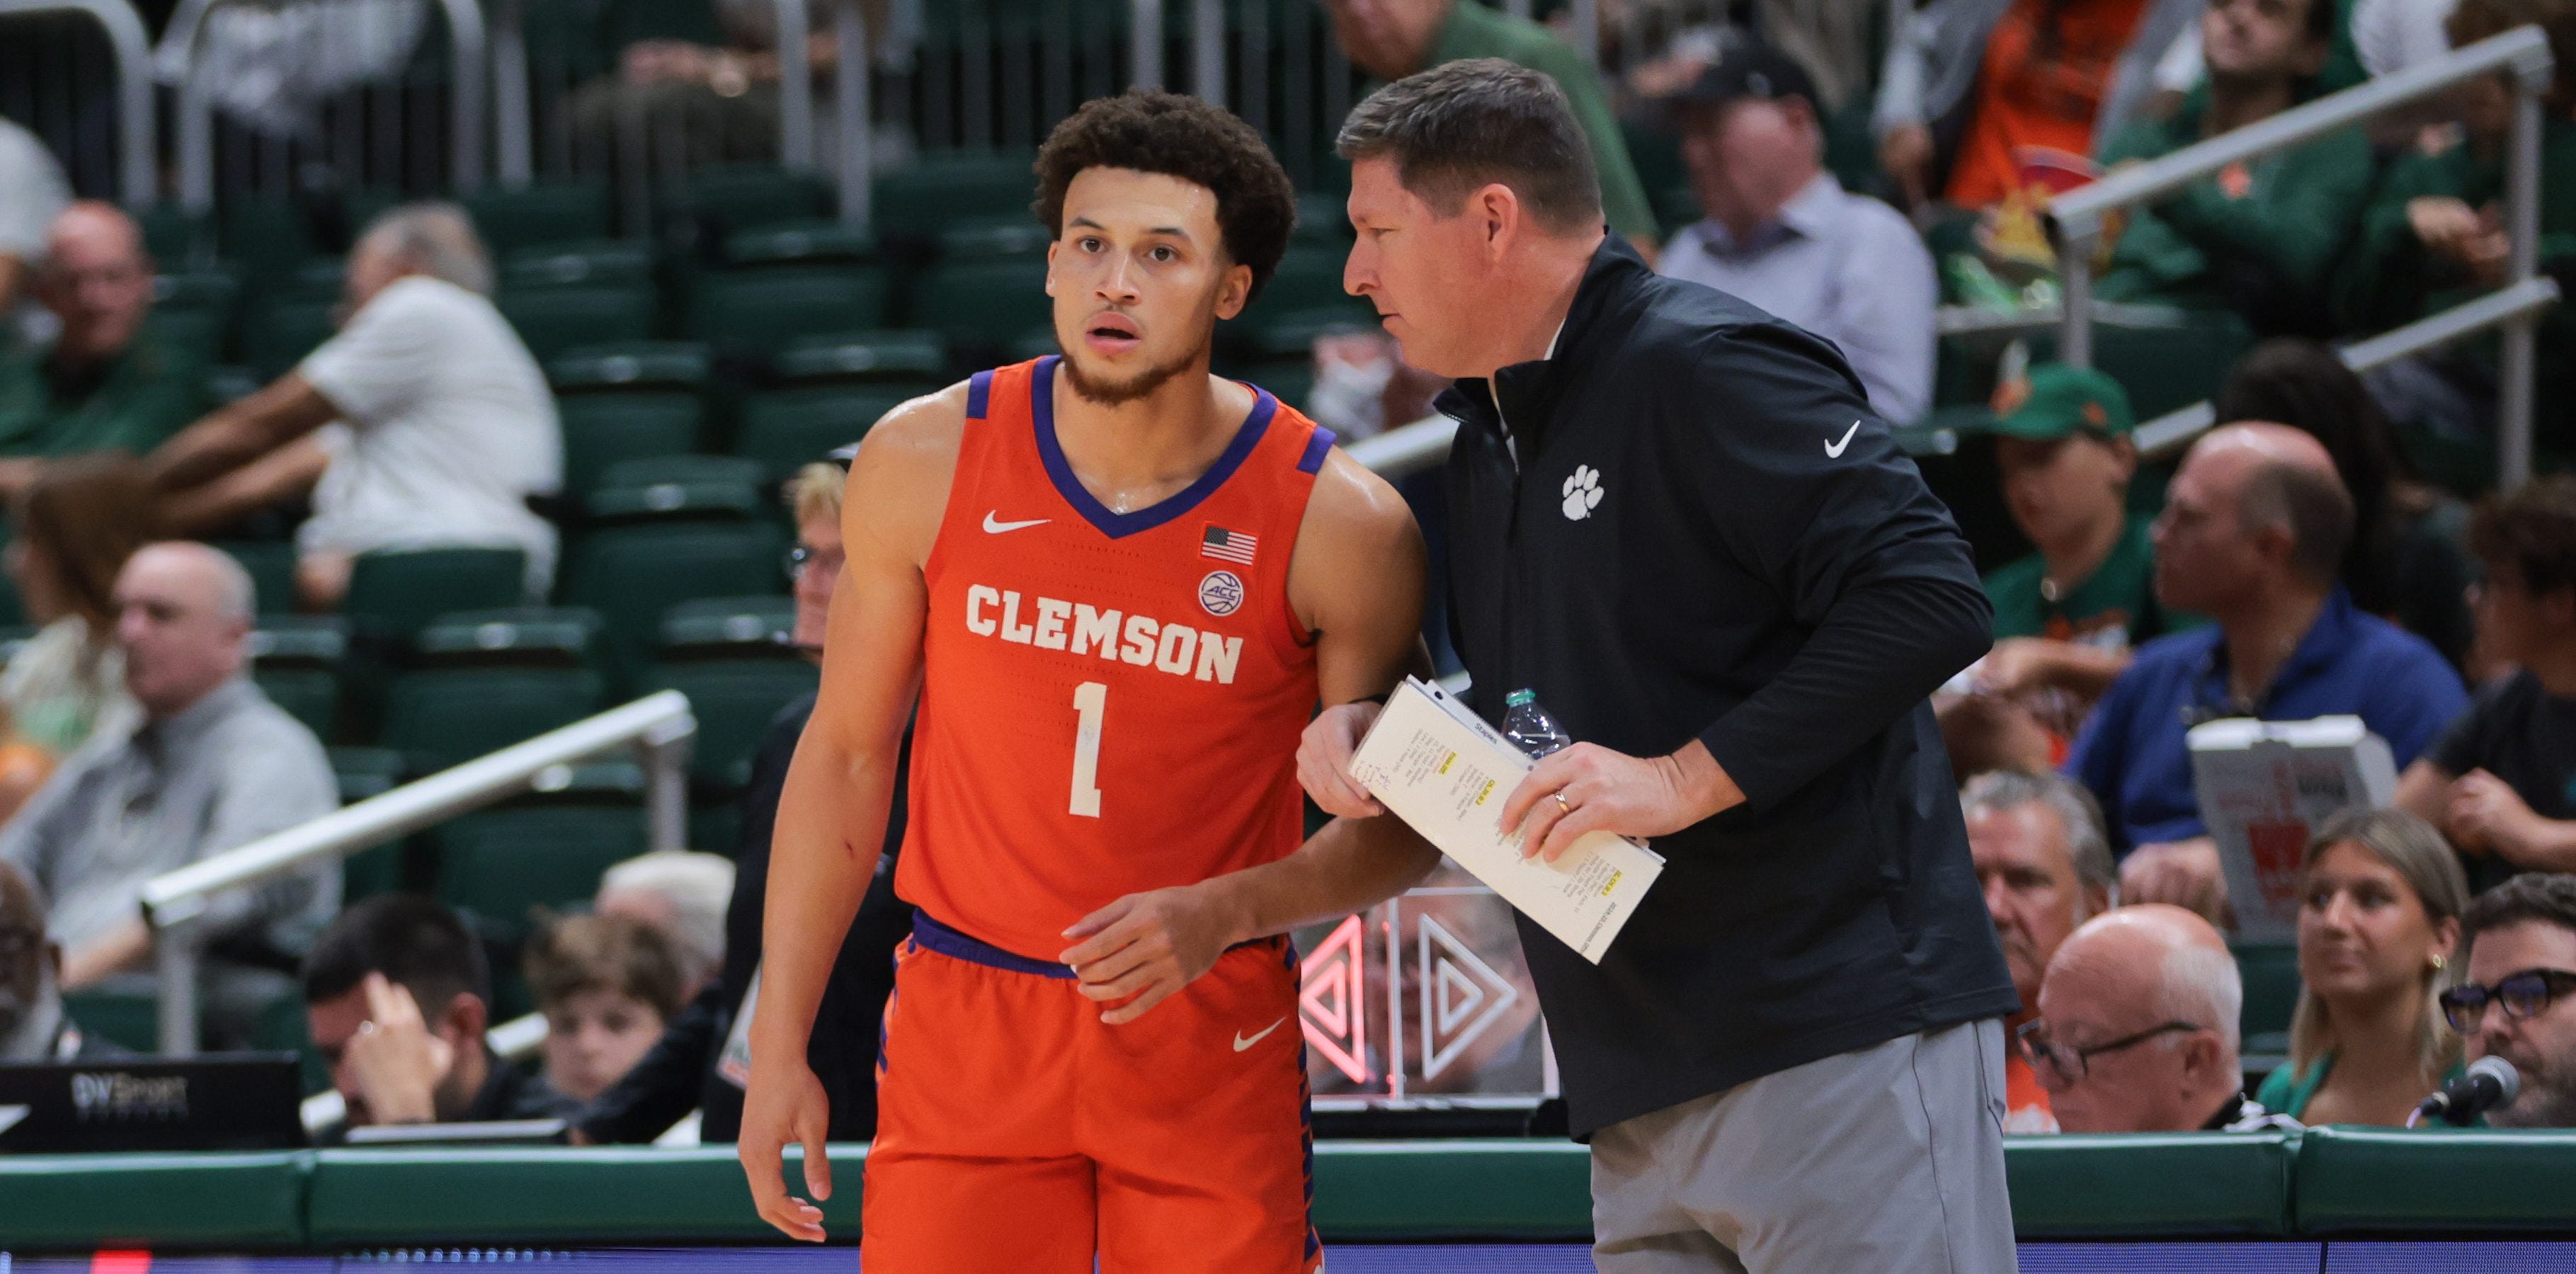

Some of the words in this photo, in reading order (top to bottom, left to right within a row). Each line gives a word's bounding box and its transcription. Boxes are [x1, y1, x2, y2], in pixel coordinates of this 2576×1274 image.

[1206, 586, 1240, 601] ACC
[967, 584, 1243, 684] CLEMSON
[1069, 681, 1107, 819] 1
[1474, 722, 1498, 745] Staples
